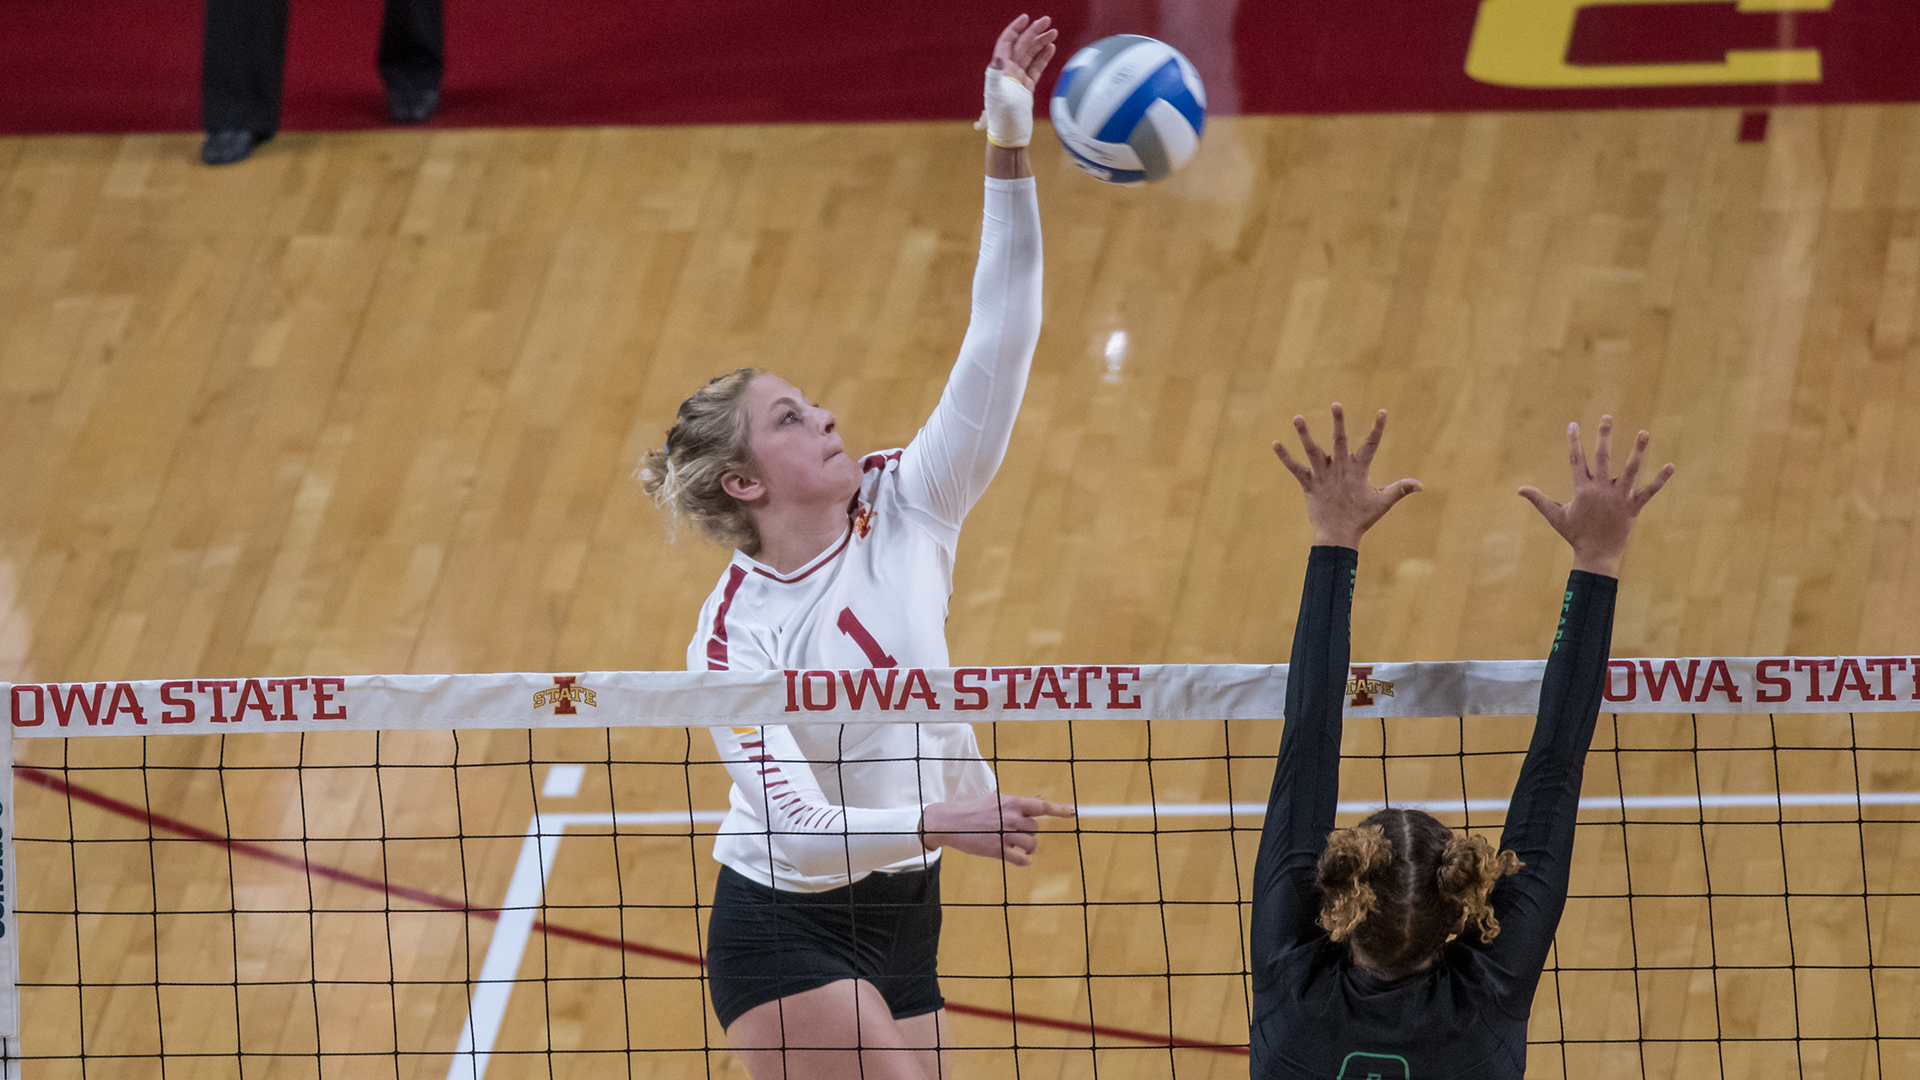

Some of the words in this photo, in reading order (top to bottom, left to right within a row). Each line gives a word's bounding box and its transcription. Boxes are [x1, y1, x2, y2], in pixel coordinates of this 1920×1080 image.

[837, 606, 898, 668] 1
[11, 683, 148, 727] OWA
[160, 678, 347, 724] STATE
[533, 686, 597, 709] STATE
[784, 668, 941, 712] IOWA
[953, 667, 1142, 710] STATE
[1345, 679, 1395, 697] TATE
[1602, 659, 1743, 702] OWA
